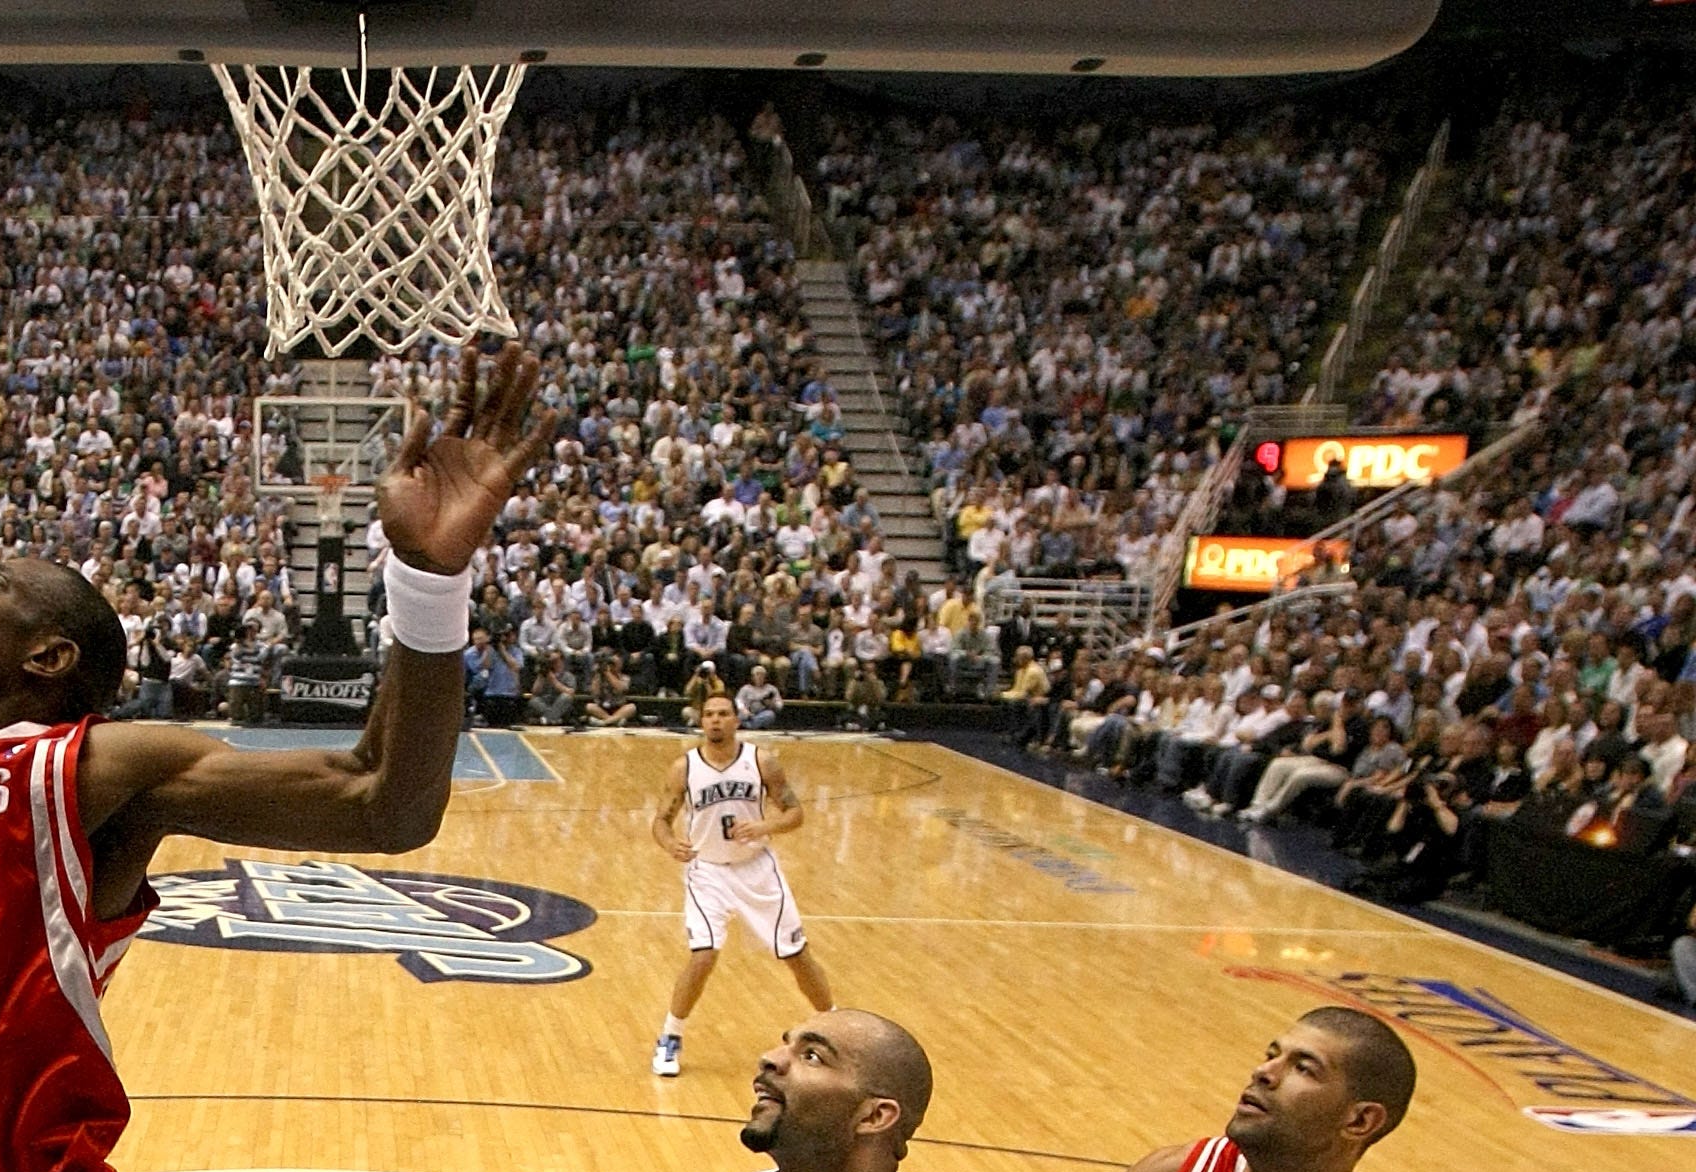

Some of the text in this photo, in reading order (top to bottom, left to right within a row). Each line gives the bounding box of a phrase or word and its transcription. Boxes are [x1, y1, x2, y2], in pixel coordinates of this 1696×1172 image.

[1346, 443, 1439, 480] PDC
[1225, 548, 1285, 577] PDC
[291, 681, 371, 698] PLAYOFFS
[695, 781, 758, 812] JAZZ
[216, 859, 585, 980] JAZZ
